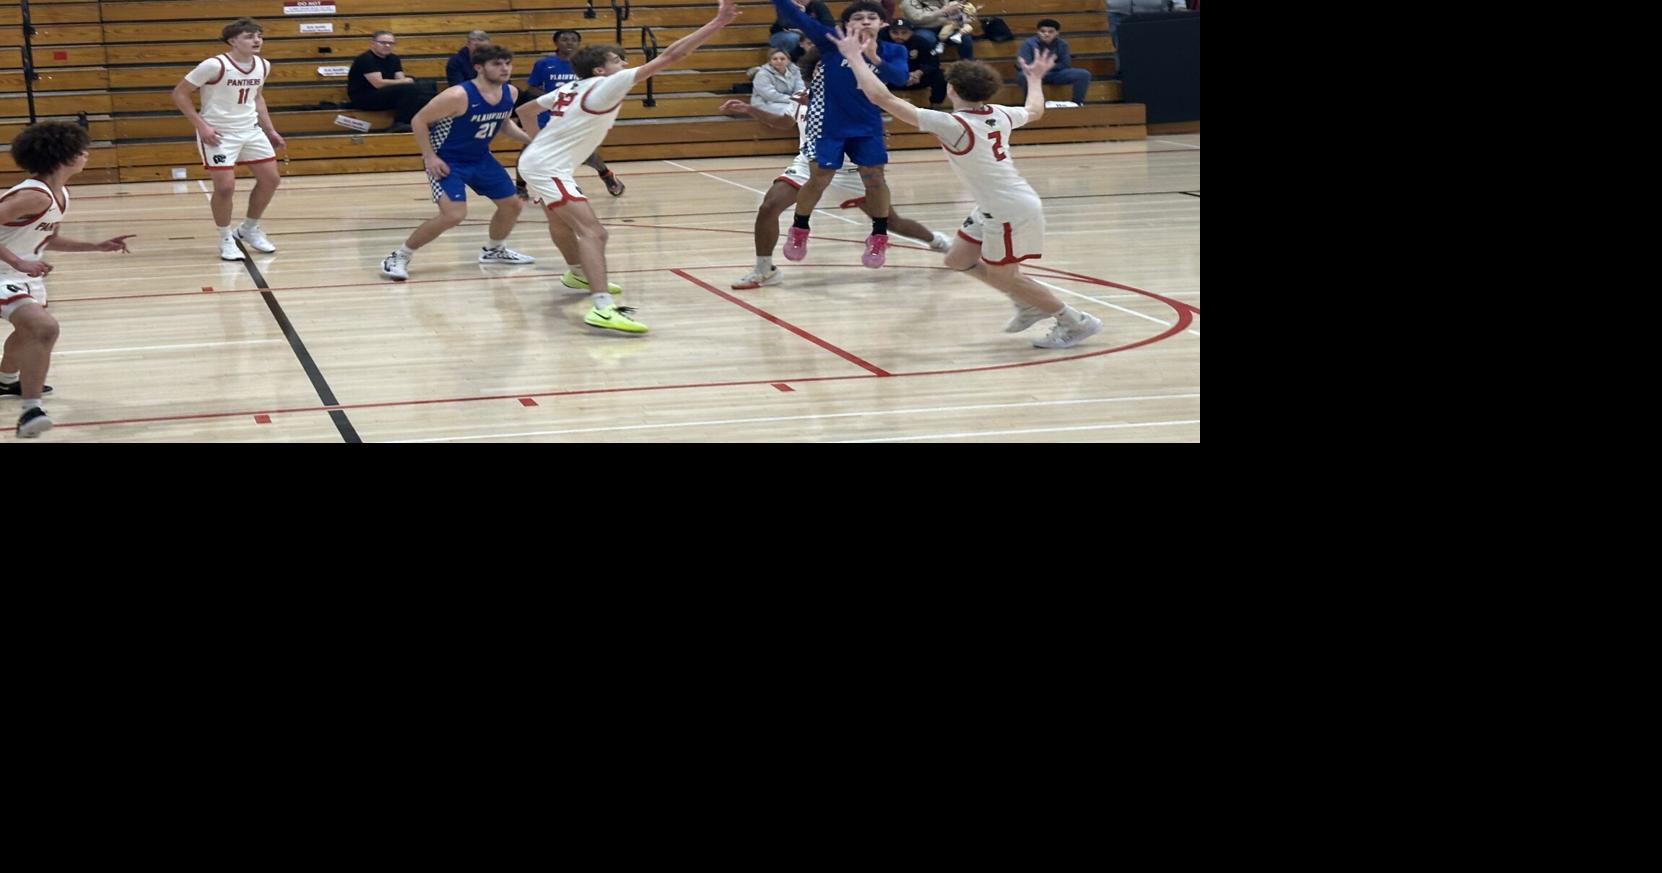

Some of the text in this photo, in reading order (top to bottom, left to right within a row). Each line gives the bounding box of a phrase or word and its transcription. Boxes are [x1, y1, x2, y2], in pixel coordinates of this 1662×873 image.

[227, 78, 261, 87] PANTHERS
[237, 87, 250, 105] 11
[474, 121, 498, 139] 21
[987, 130, 1006, 161] 2
